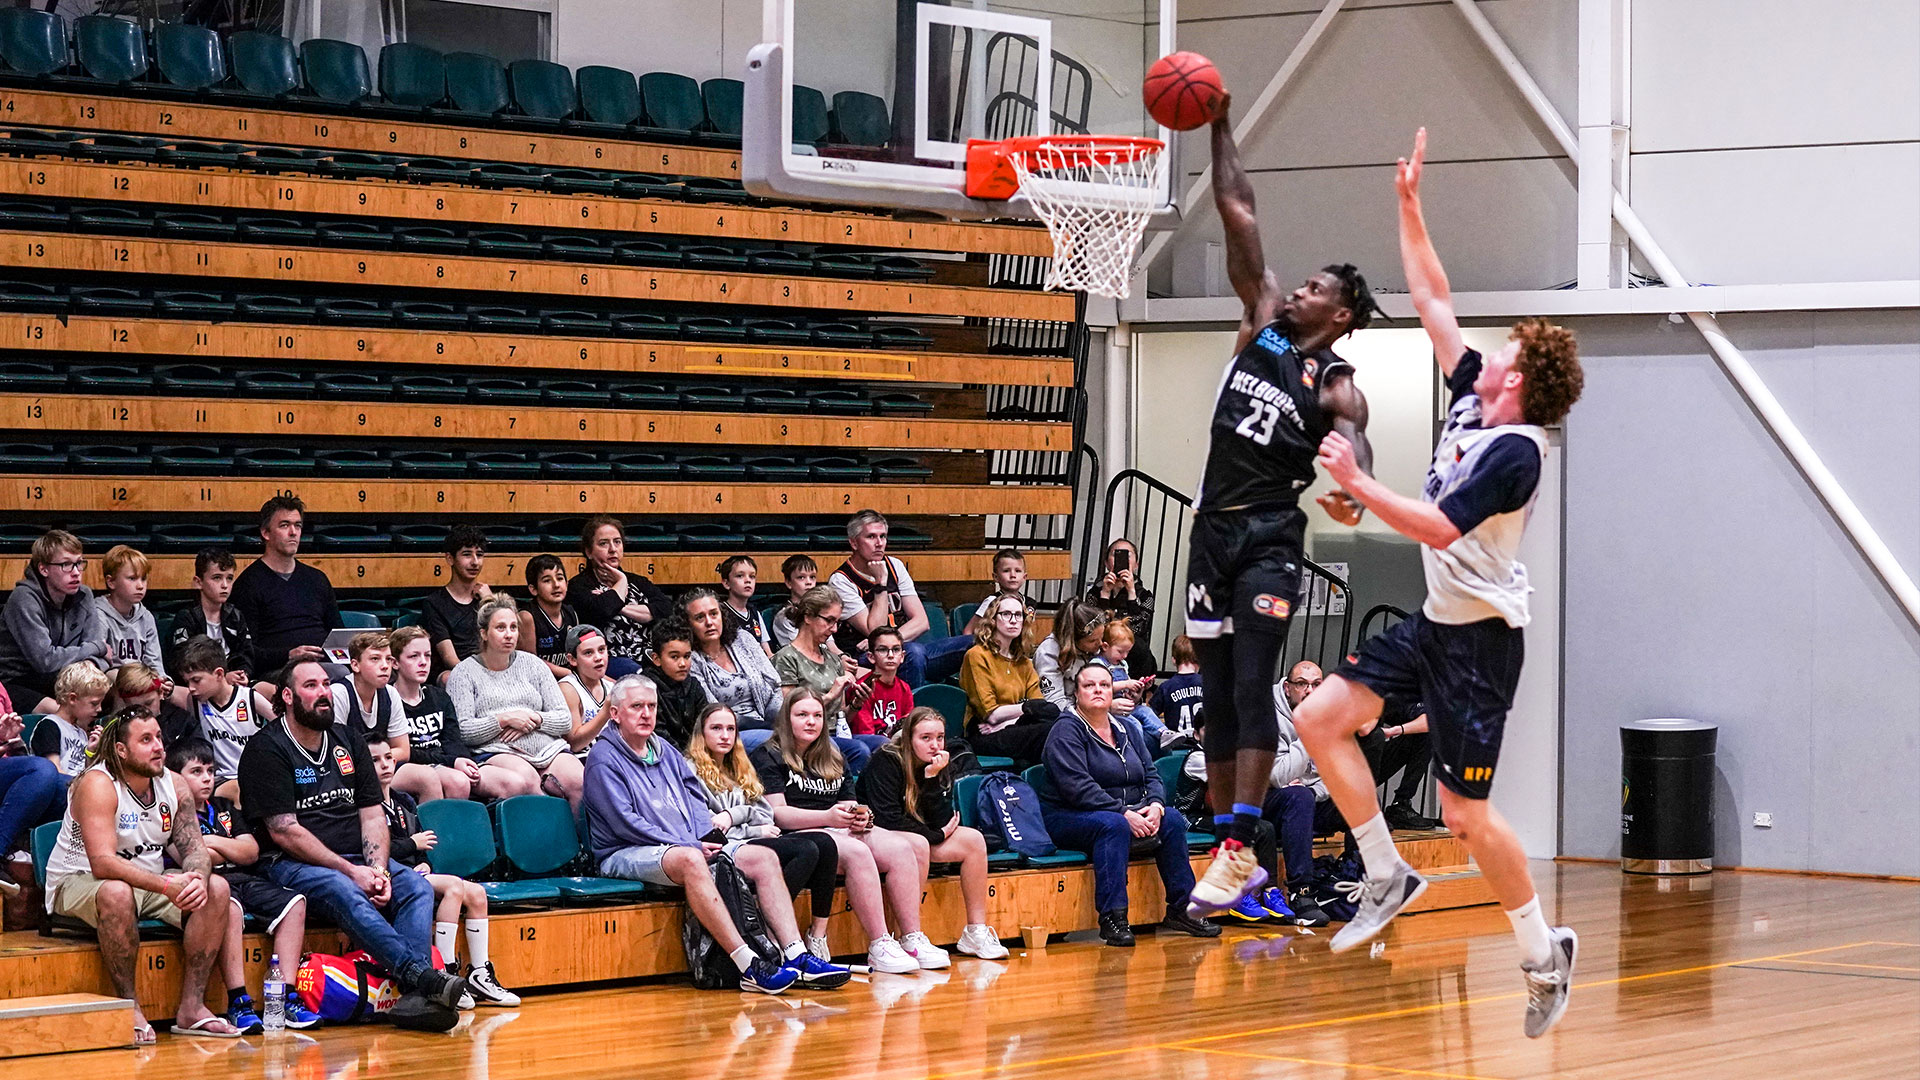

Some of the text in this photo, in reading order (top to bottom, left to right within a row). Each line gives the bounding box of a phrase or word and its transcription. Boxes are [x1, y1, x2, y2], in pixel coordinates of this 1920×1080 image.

[80, 105, 96, 119] 13
[159, 112, 173, 126] 12
[238, 118, 247, 131] 11
[314, 124, 329, 138] 10
[389, 131, 397, 144] 9
[459, 137, 467, 149] 8
[529, 143, 537, 154] 7
[595, 147, 603, 159] 6
[662, 154, 669, 166] 5
[730, 160, 738, 171] 4
[29, 171, 46, 185] 13
[114, 176, 130, 191] 12
[198, 182, 209, 196] 11
[278, 187, 294, 201] 10
[358, 192, 367, 206] 9
[436, 198, 444, 211] 8
[510, 202, 518, 215] 7
[581, 206, 589, 218] 6
[650, 211, 658, 224] 5
[716, 216, 724, 228] 4
[781, 220, 789, 232] 3
[845, 224, 853, 236] 2
[28, 243, 45, 258] 13
[114, 248, 129, 262] 12
[197, 252, 208, 266] 11
[278, 257, 294, 271] 10
[357, 261, 366, 274] 9
[436, 265, 444, 279] 8
[509, 270, 517, 282] 7
[580, 273, 589, 286] 6
[649, 278, 657, 290] 5
[719, 282, 727, 294] 4
[782, 285, 790, 298] 3
[846, 289, 854, 301] 2
[26, 325, 43, 340] 13
[113, 328, 129, 343] 12
[196, 332, 207, 346] 11
[278, 335, 294, 349] 10
[357, 339, 366, 352] 9
[436, 342, 444, 355] 8
[508, 345, 517, 357] 7
[579, 347, 588, 361] 6
[649, 351, 657, 363] 5
[715, 353, 723, 366] 4
[781, 355, 789, 368] 3
[843, 358, 851, 370] 2
[27, 405, 43, 419] 13
[112, 407, 129, 421] 12
[196, 409, 207, 423] 11
[278, 411, 295, 425] 10
[358, 413, 366, 426] 9
[434, 415, 442, 428] 8
[508, 417, 517, 430] 7
[579, 418, 587, 431] 6
[648, 421, 656, 433] 5
[714, 423, 722, 435] 4
[780, 424, 788, 437] 3
[844, 426, 852, 438] 2
[1235, 397, 1280, 446] 23
[26, 485, 44, 500] 13
[112, 487, 128, 501] 12
[200, 488, 211, 501] 11
[358, 489, 367, 503] 9
[436, 490, 445, 503] 8
[507, 491, 516, 503] 7
[579, 490, 587, 503] 6
[648, 491, 656, 504] 5
[715, 492, 723, 504] 4
[780, 493, 788, 505] 3
[843, 493, 851, 505] 2
[357, 565, 366, 578] 9
[433, 564, 442, 577] 8
[506, 564, 515, 576] 7
[647, 563, 655, 575] 5
[1170, 685, 1204, 703] GOULDIN
[406, 711, 444, 735] ASEY
[295, 765, 316, 777] soda
[119, 811, 139, 823] soda
[148, 954, 166, 970] 16
[245, 948, 263, 963] 15
[520, 926, 536, 942] 12
[604, 920, 616, 935] 11
[988, 884, 996, 898] 6
[1057, 880, 1065, 893] 5
[295, 980, 315, 992] AST
[296, 968, 315, 980] RST,
